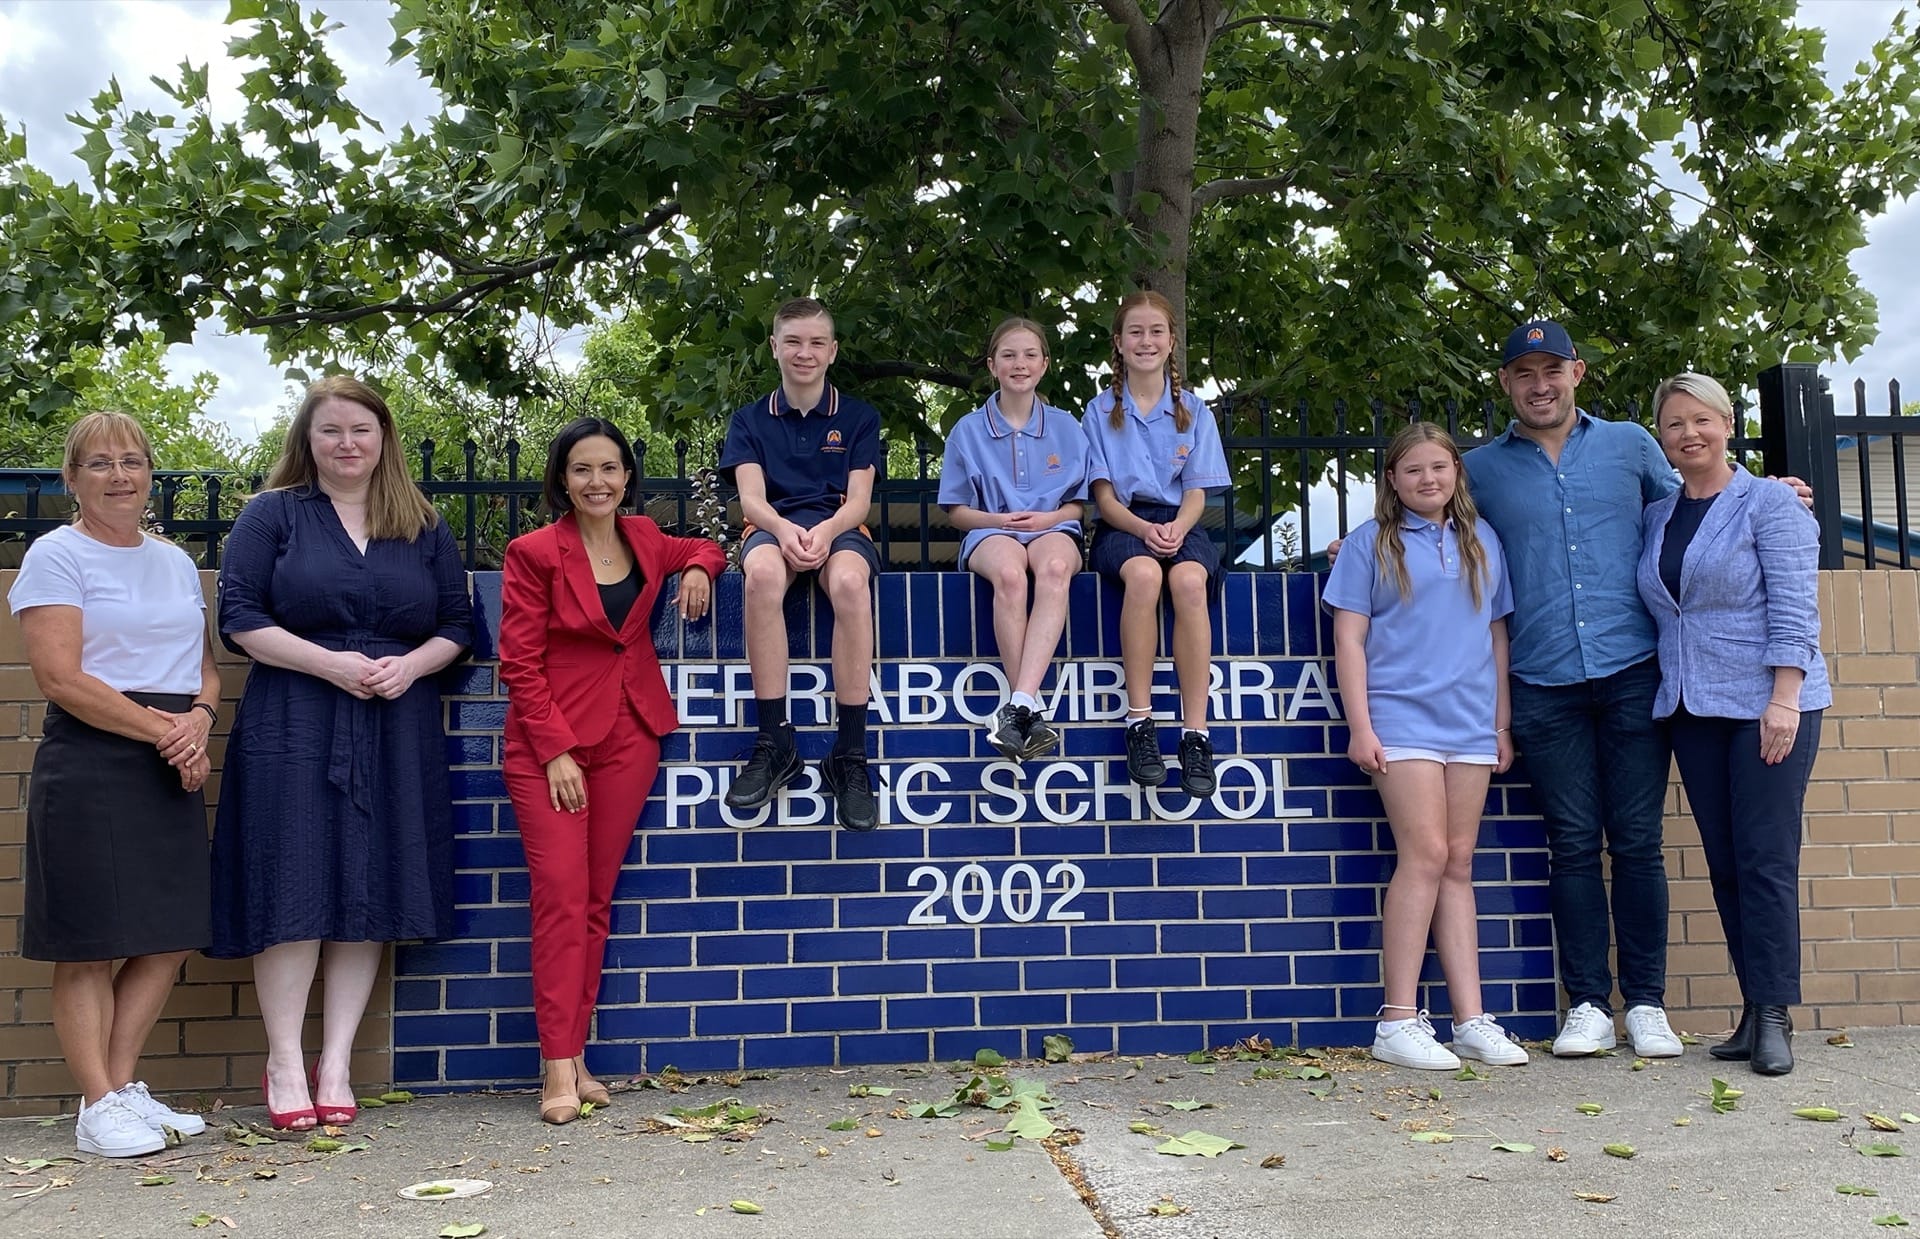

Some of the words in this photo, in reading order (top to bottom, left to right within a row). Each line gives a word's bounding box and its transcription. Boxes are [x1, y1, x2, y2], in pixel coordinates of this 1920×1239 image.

[660, 662, 1341, 725] ERRBOMBERA
[666, 762, 952, 829] PUBIC
[978, 758, 1313, 824] SCHOOL
[907, 863, 1086, 925] 2002
